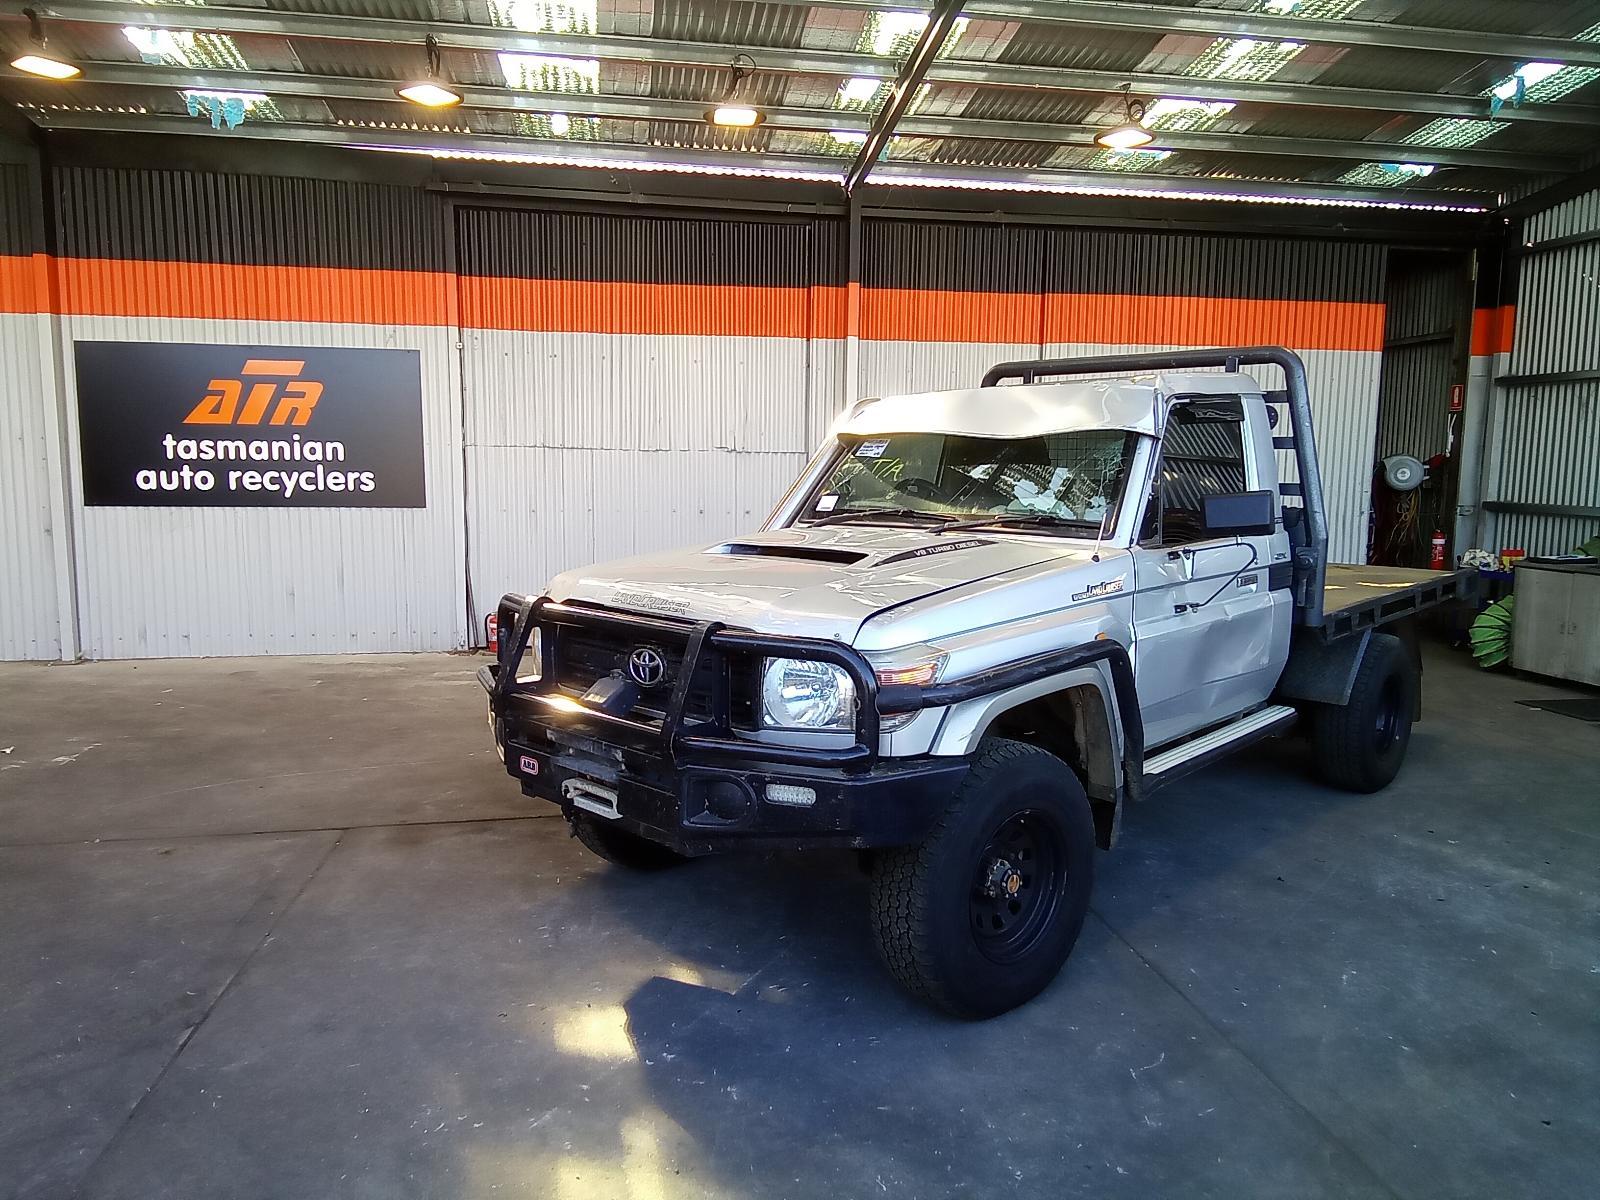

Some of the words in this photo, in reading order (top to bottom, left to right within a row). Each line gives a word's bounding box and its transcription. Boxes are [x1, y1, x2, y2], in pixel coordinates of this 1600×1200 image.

[182, 359, 324, 426] ATR
[162, 433, 345, 462] tasmanian
[135, 464, 215, 492] auto
[228, 464, 376, 498] recyclers
[927, 544, 955, 554] TURBO
[955, 540, 982, 550] DIESEL
